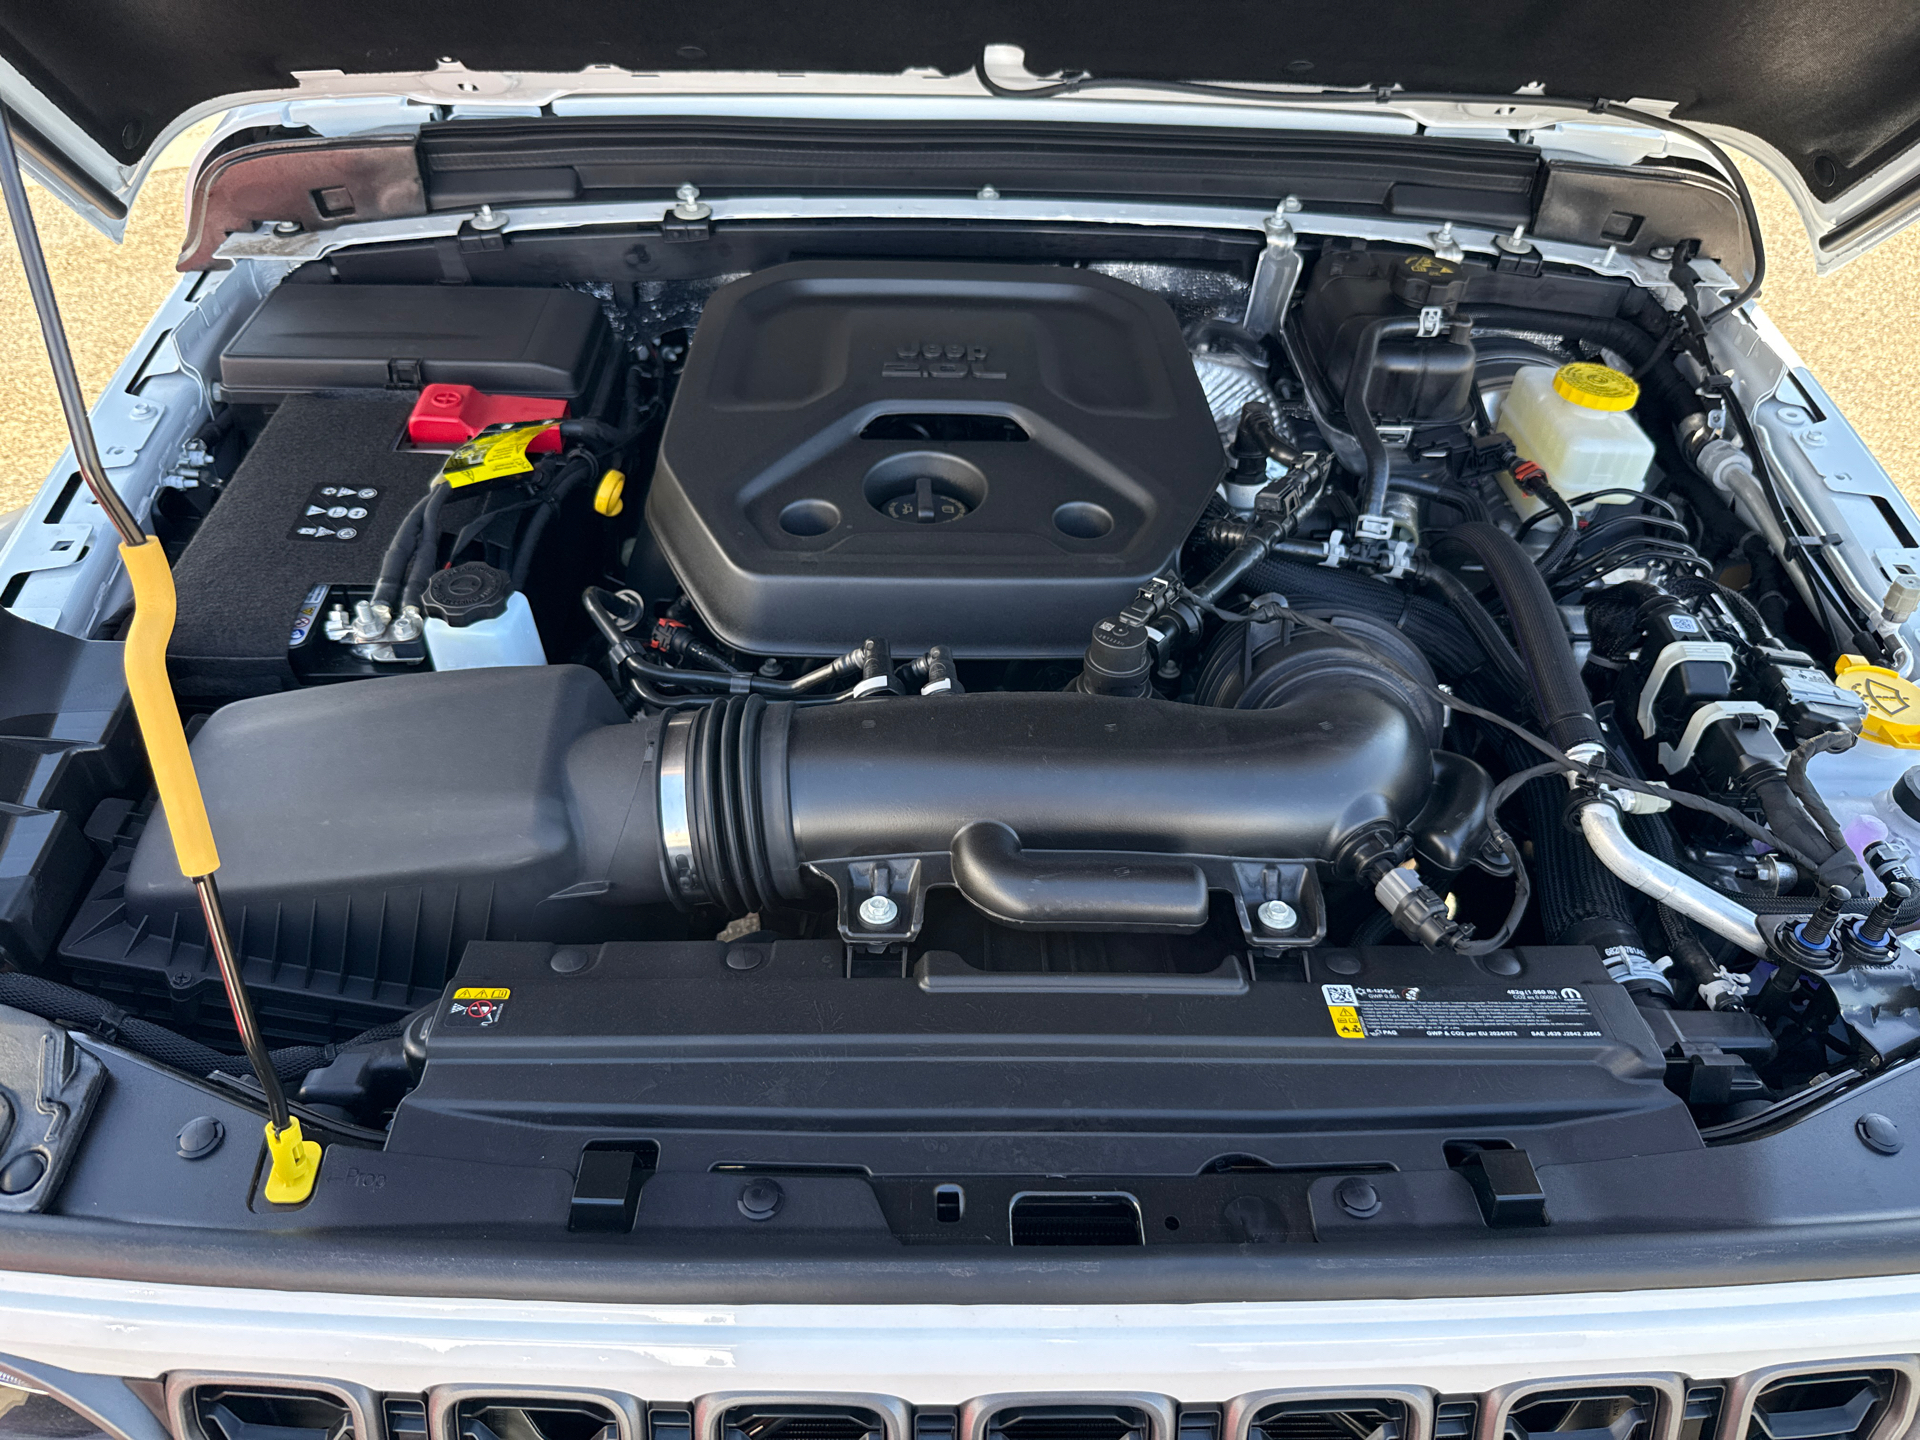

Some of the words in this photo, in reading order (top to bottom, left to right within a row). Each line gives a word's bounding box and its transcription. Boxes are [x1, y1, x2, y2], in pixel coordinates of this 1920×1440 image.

[897, 341, 988, 361] Jeep
[882, 362, 1007, 379] 2.0L
[345, 1167, 387, 1193] Prop
